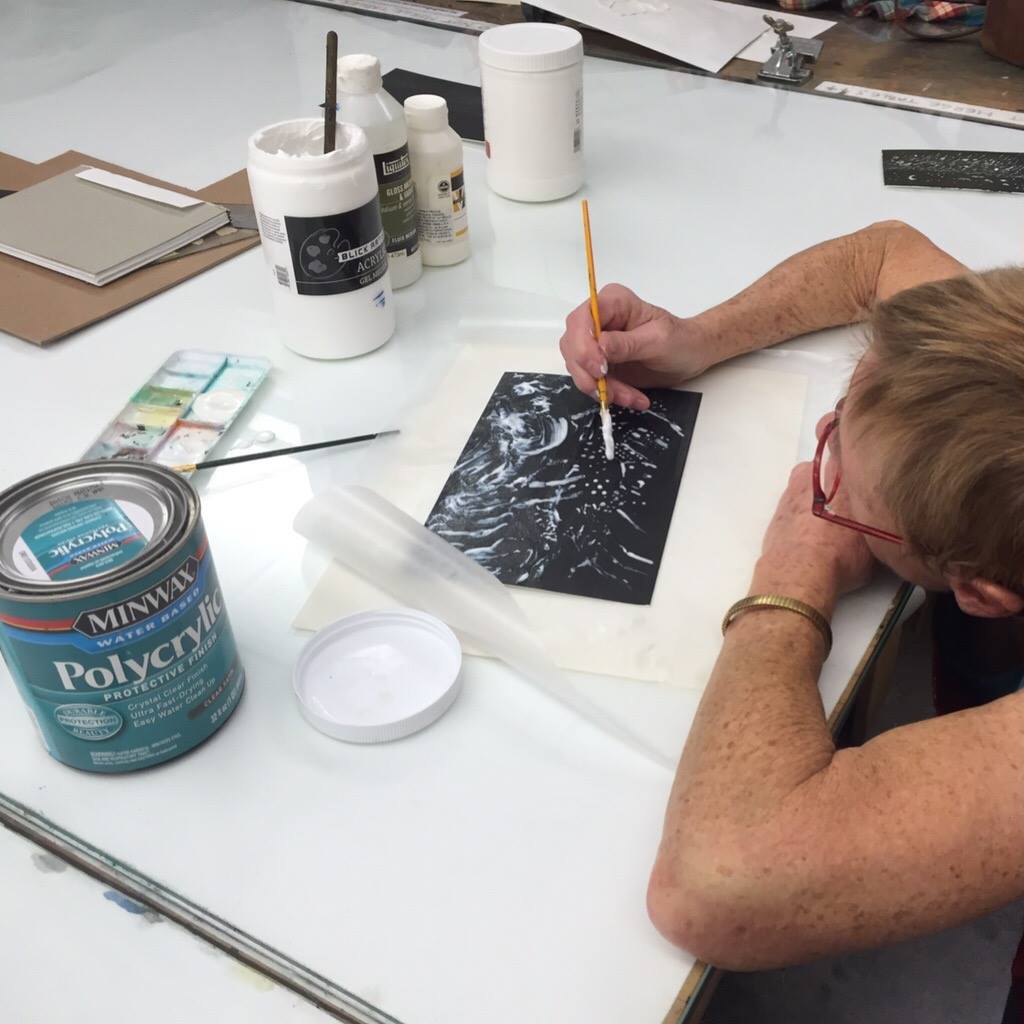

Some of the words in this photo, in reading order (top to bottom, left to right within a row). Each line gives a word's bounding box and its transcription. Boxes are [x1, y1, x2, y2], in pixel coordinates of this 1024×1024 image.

[341, 246, 368, 261] BLICK
[48, 522, 128, 558] Polycrylic
[88, 563, 195, 633] MINWAX
[97, 622, 155, 647] WATER
[161, 587, 199, 623] BASED
[53, 588, 224, 690] Polycrylic
[104, 664, 185, 701] PROTECTIVE
[188, 634, 218, 666] FINISH
[128, 695, 161, 711] Crystal
[130, 707, 155, 720] Ultra
